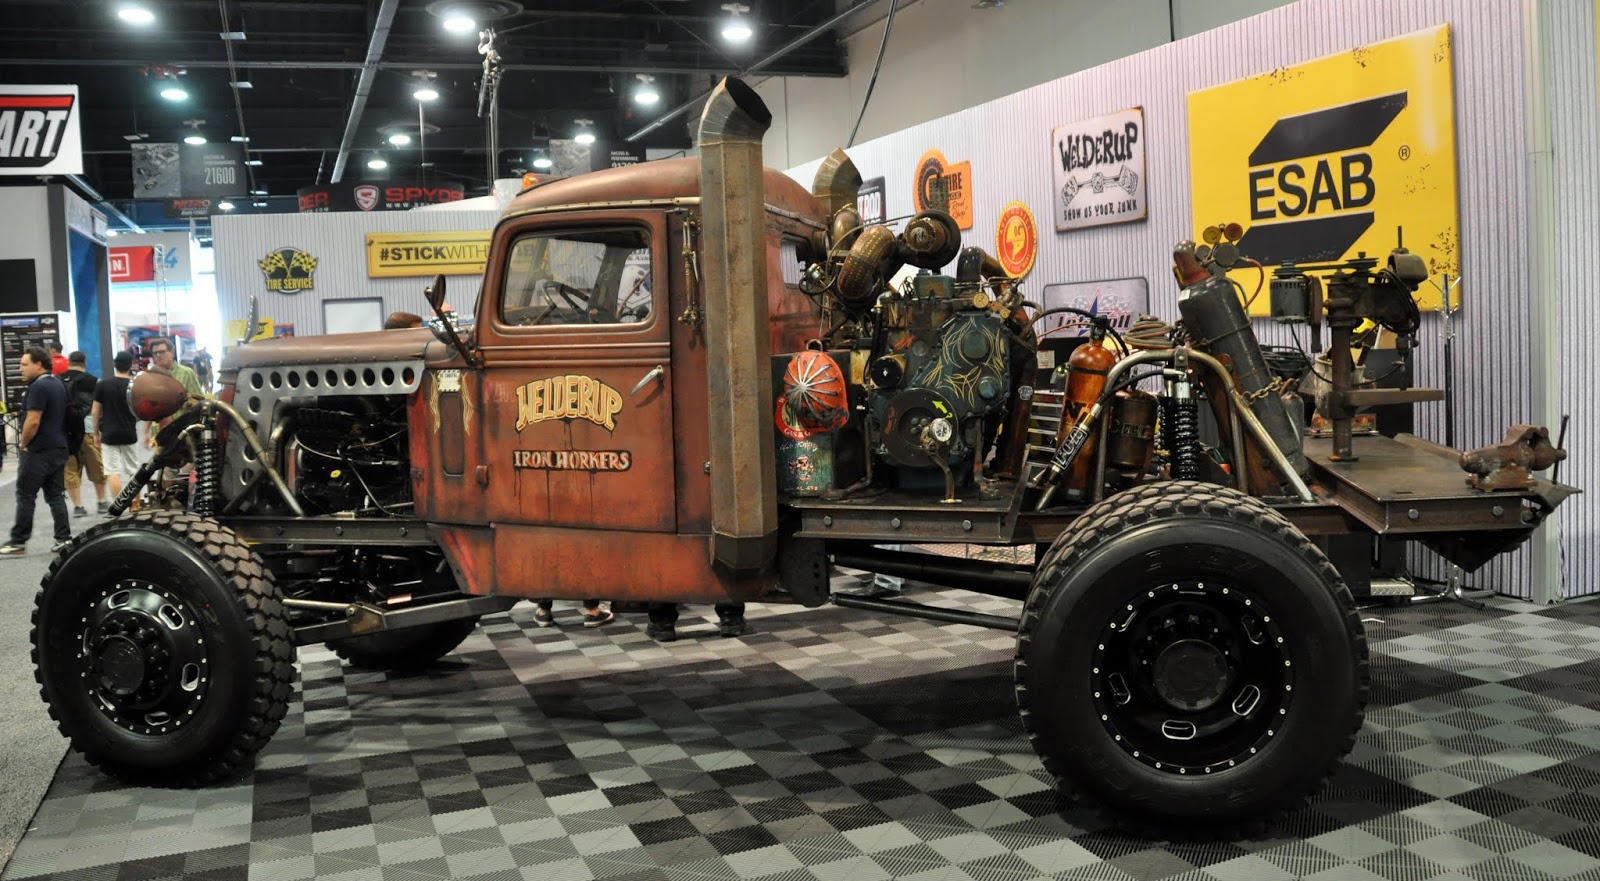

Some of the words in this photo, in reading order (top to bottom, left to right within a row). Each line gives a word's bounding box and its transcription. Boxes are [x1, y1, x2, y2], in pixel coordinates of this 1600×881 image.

[204, 167, 236, 185] 21600
[1248, 152, 1376, 221] ESAB
[379, 245, 488, 261] #STICKWITH
[266, 279, 283, 290] TIRE
[283, 278, 313, 290] SERVICE
[516, 375, 622, 432] WELDERUP
[513, 450, 550, 469] IRON
[555, 450, 631, 470] WORKERS
